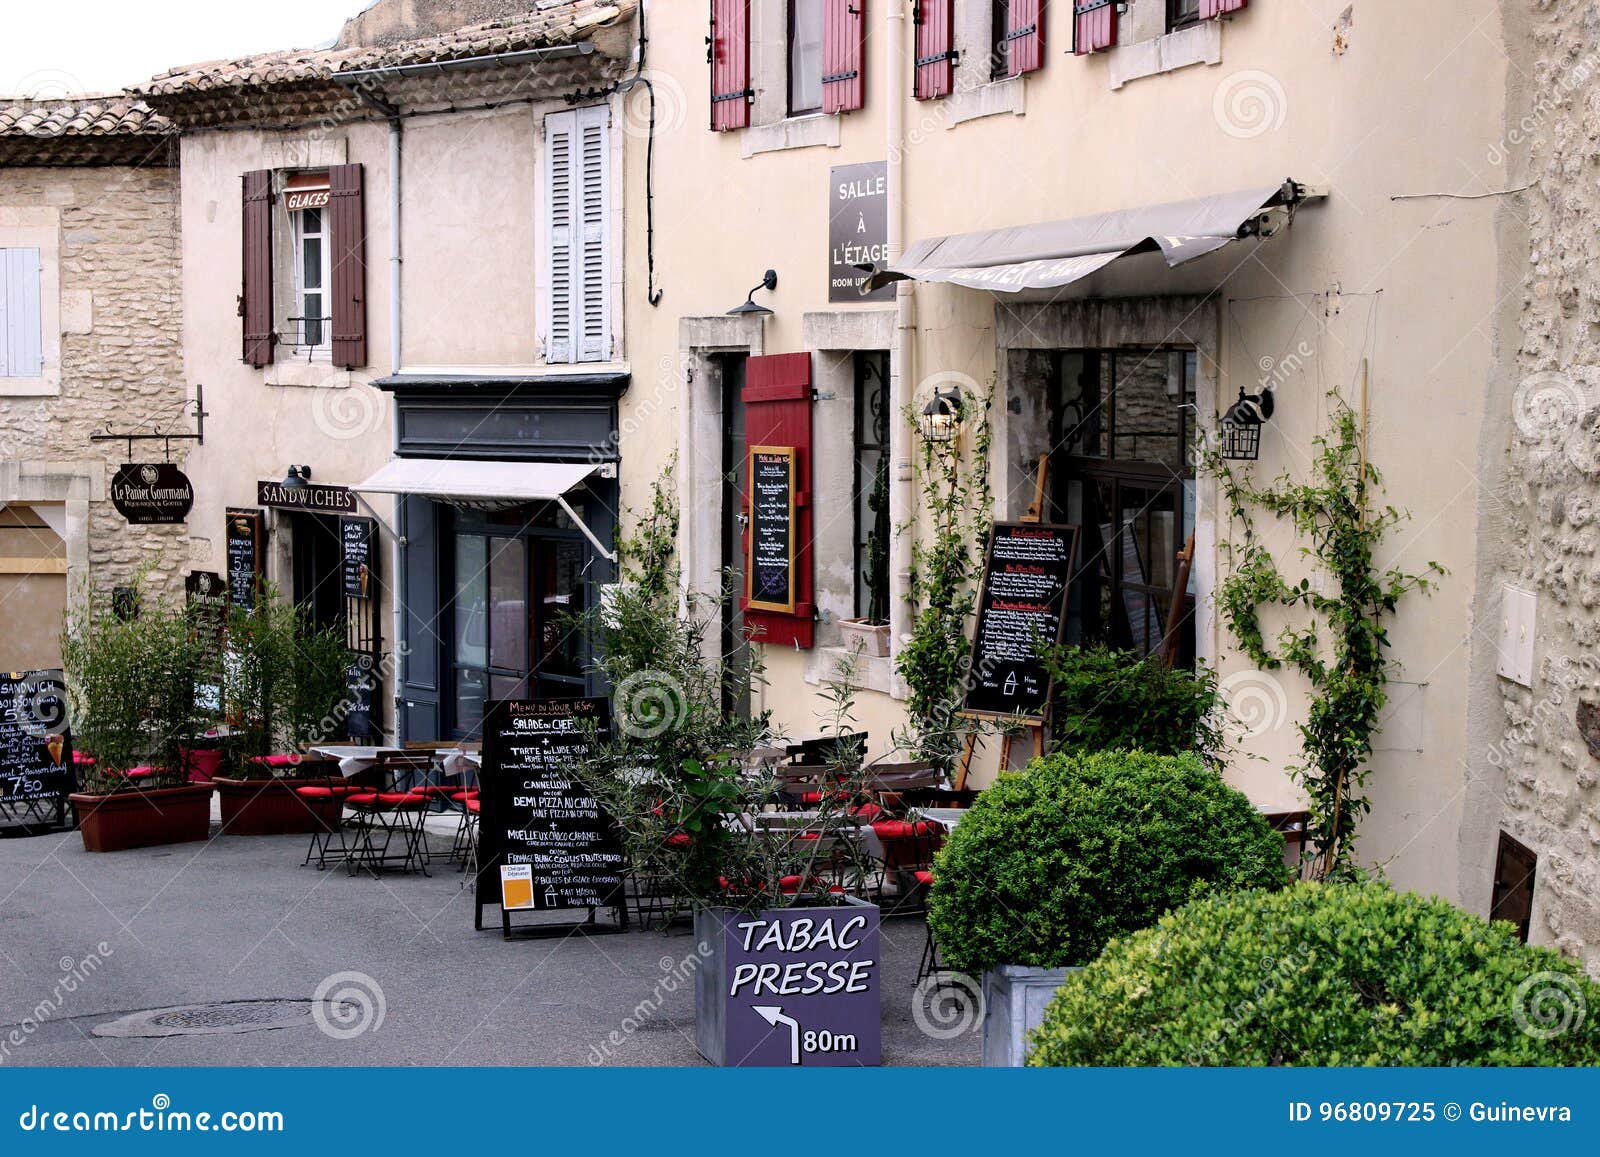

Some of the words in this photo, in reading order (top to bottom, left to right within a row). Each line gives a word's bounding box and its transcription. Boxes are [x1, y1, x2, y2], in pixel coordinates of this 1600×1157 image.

[839, 177, 885, 200] SALLE
[288, 192, 329, 208] GLACES
[857, 211, 866, 233] À
[831, 278, 853, 287] ROOM
[113, 484, 124, 500] Le
[124, 484, 149, 500] Panier
[150, 483, 190, 500] Gourmand
[263, 486, 352, 507] SANDWICHES
[229, 538, 252, 546] SANDWICH
[0, 680, 55, 694] SANDWICH
[509, 701, 536, 713] MENU
[548, 700, 570, 712] JOUR
[512, 718, 544, 730] SALADE
[552, 719, 574, 730] CHEF
[510, 747, 541, 757] TARTE
[513, 796, 537, 807] DEMI
[539, 797, 564, 808] PIZZA
[575, 797, 599, 809] CHOIX
[532, 808, 548, 818] HALF
[568, 831, 604, 841] CARAMEL
[554, 854, 580, 863] COULIS
[737, 915, 865, 952] TABAC
[730, 960, 873, 996] PRESSE
[802, 1029, 857, 1053] 80m
